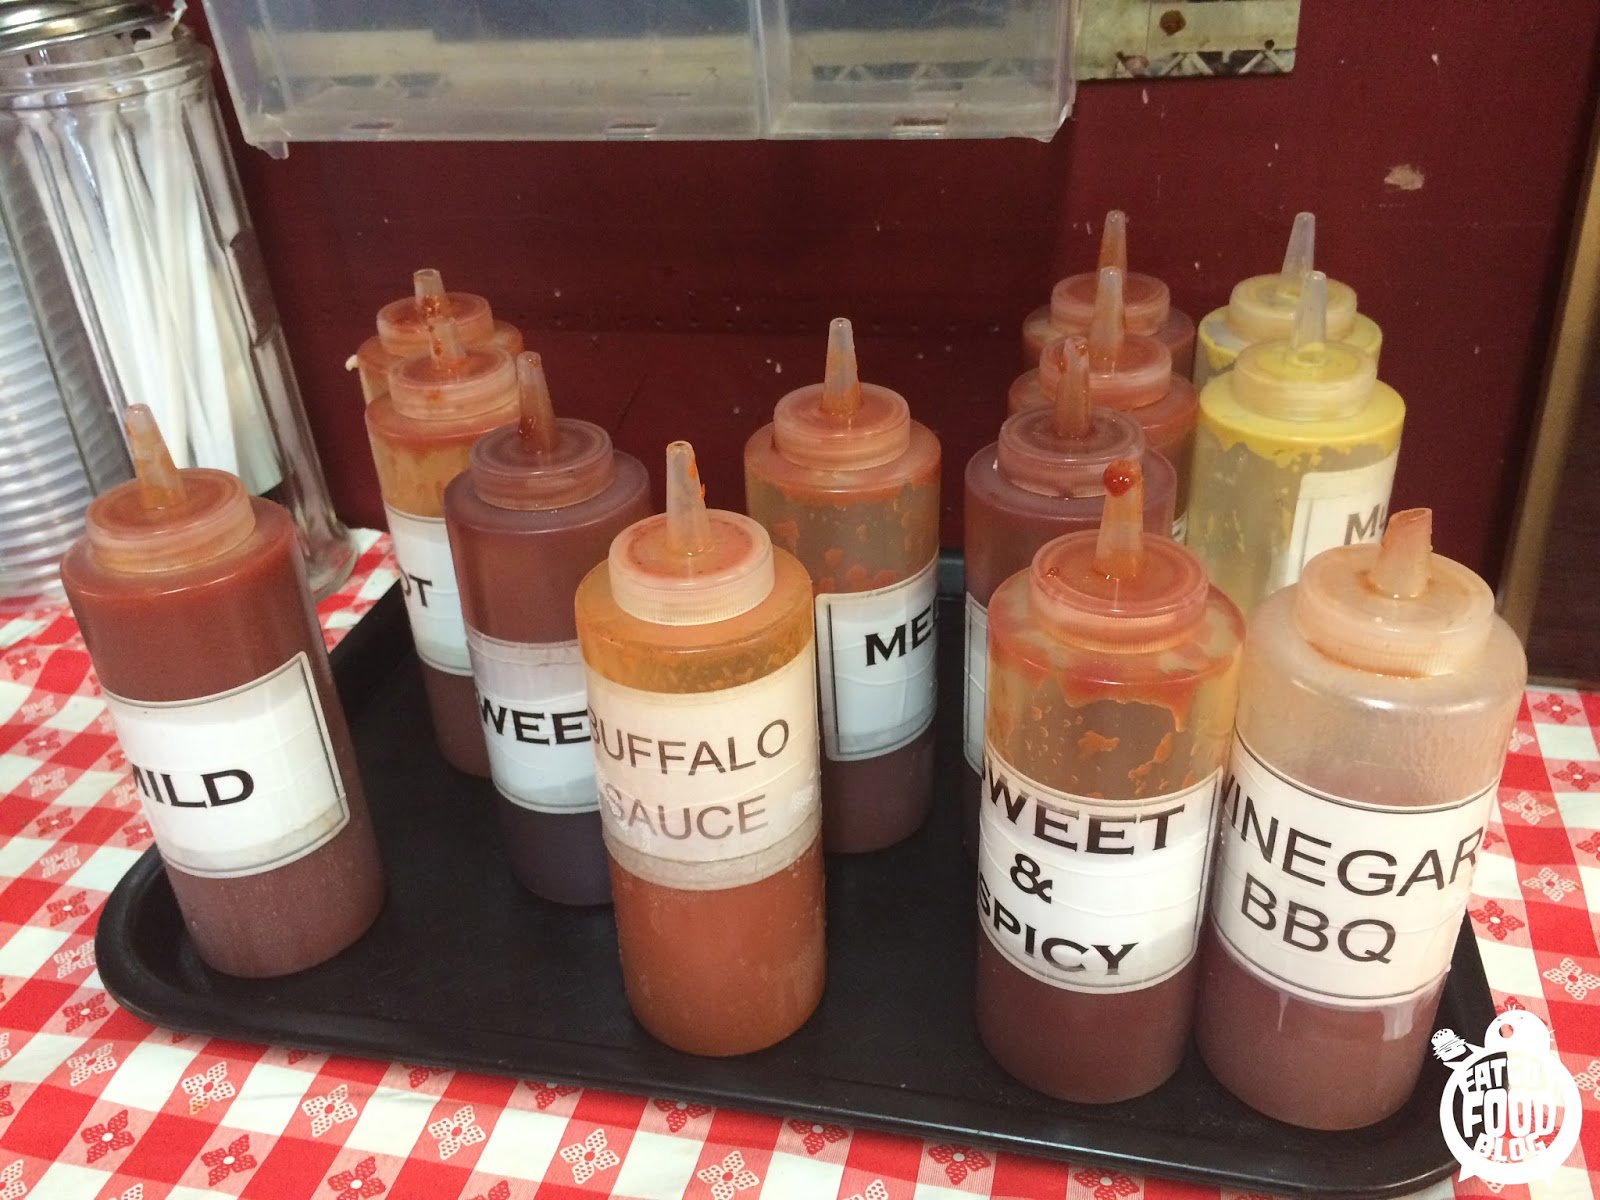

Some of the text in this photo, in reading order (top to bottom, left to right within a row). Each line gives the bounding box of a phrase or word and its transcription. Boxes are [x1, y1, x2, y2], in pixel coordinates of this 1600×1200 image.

[1344, 503, 1385, 546] M
[864, 600, 937, 667] ME
[478, 694, 591, 746] WEE
[588, 704, 790, 776] BUFFALO
[605, 783, 769, 841] SAUCE
[982, 752, 1186, 856] WEET
[1010, 853, 1053, 904] &
[979, 871, 1140, 976] SPICY
[1241, 872, 1397, 965] BBQ
